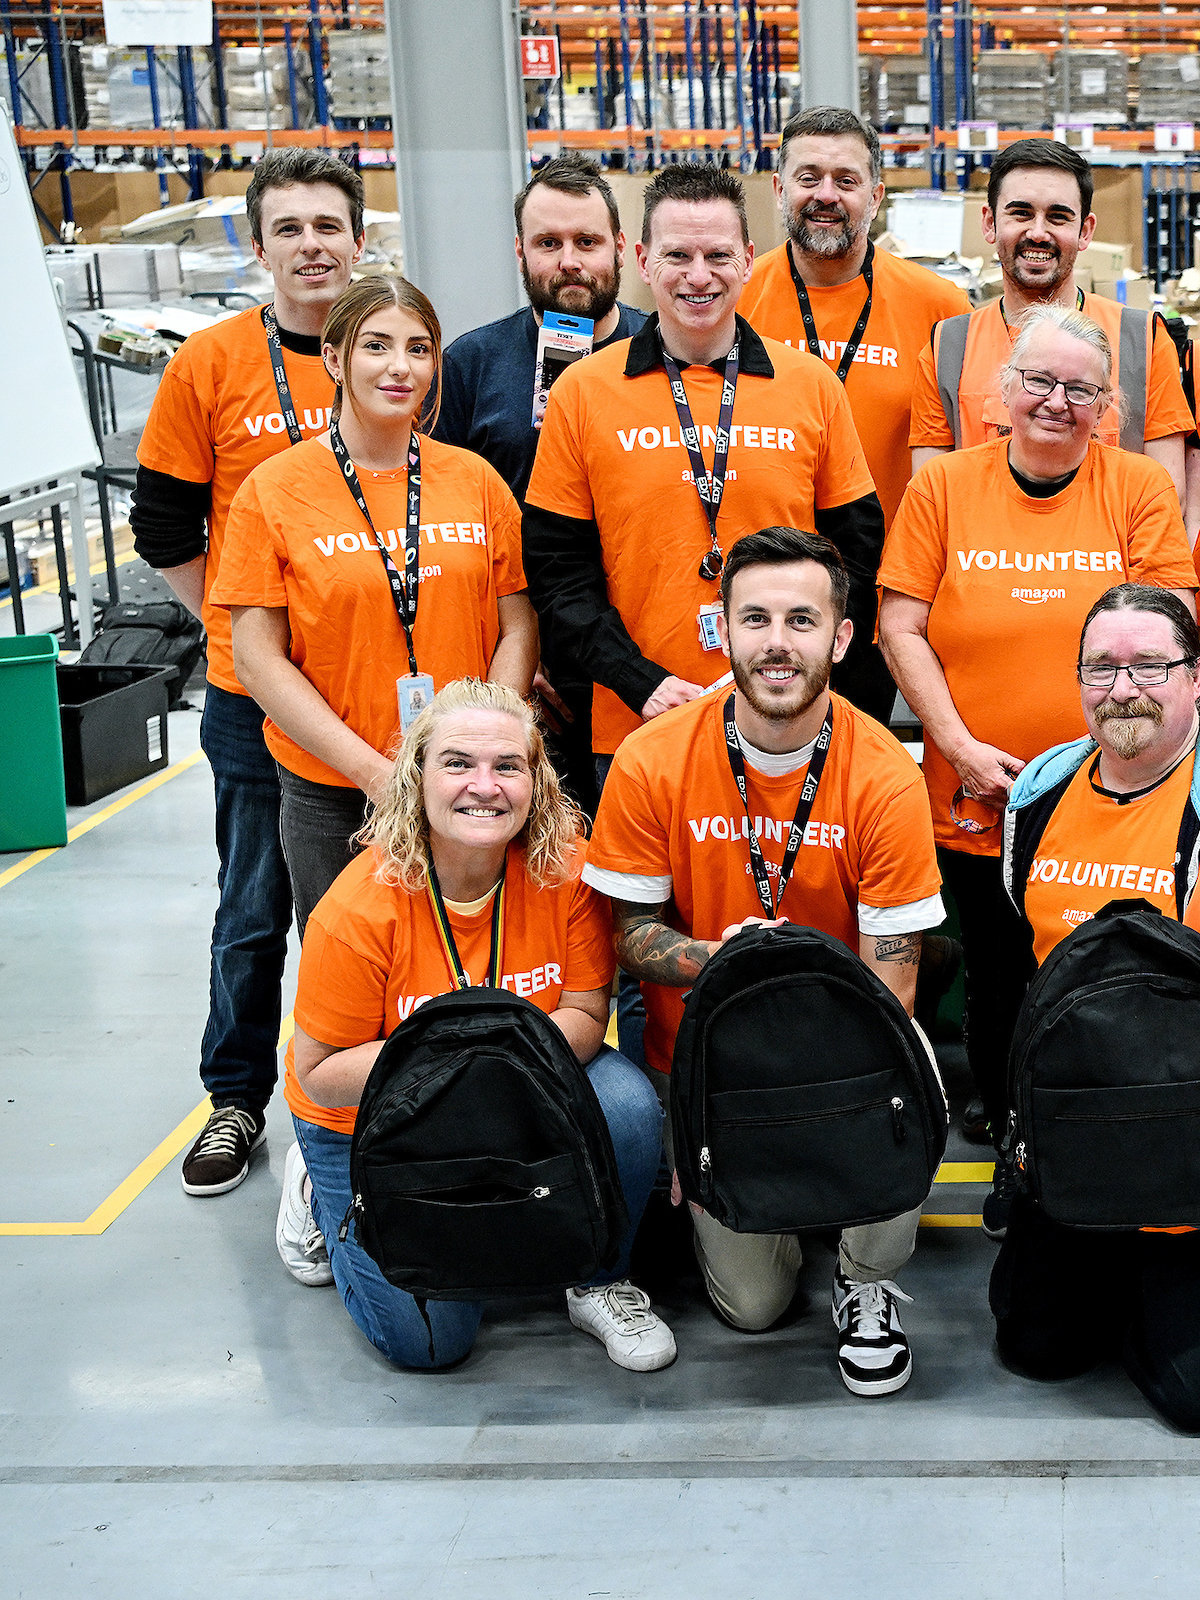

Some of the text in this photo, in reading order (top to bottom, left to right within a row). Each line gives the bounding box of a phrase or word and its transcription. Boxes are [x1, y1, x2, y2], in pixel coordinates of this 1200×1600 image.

[672, 381, 688, 405] EDI7
[722, 380, 736, 406] EDI7
[244, 407, 334, 437] VOU
[685, 427, 700, 453] EDI7
[716, 427, 729, 454] EDI7
[697, 476, 711, 503] EDI7
[712, 476, 724, 503] EDI7
[956, 549, 1123, 573] VOLUNTEER
[1011, 587, 1066, 602] amazon
[726, 721, 740, 750] EDI7
[817, 721, 833, 750] EDI7
[737, 775, 747, 803] EDI7
[801, 772, 818, 801] EDI7
[749, 829, 761, 855] EDI7
[787, 824, 803, 851] EDI7
[1030, 859, 1175, 896] VOLUNTEER
[759, 879, 773, 909] EDI7
[1062, 908, 1095, 923] amaz
